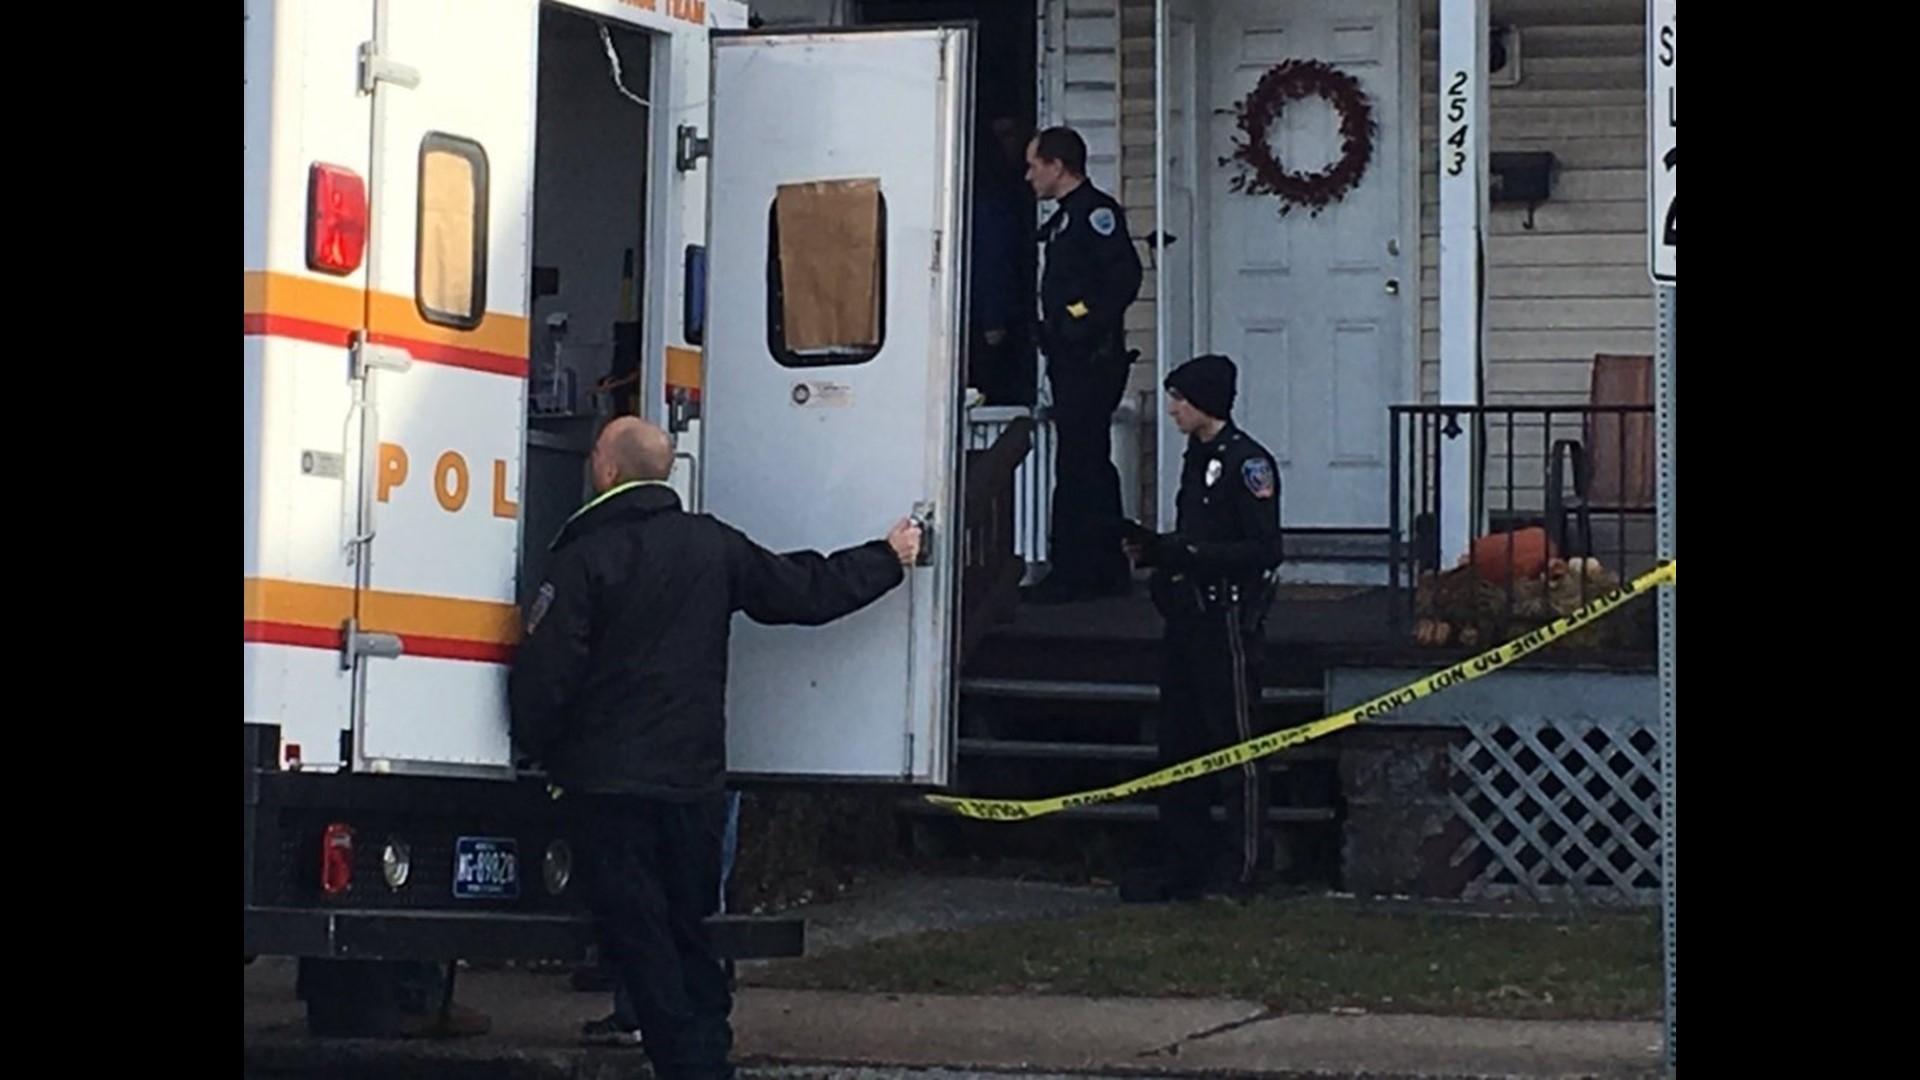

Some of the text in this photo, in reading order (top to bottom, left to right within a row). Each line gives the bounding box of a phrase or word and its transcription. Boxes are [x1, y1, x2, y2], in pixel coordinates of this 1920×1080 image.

[1447, 71, 1468, 176] 2543
[377, 442, 518, 519] POL
[1511, 623, 1557, 655] LINE
[1428, 666, 1467, 693] NOT
